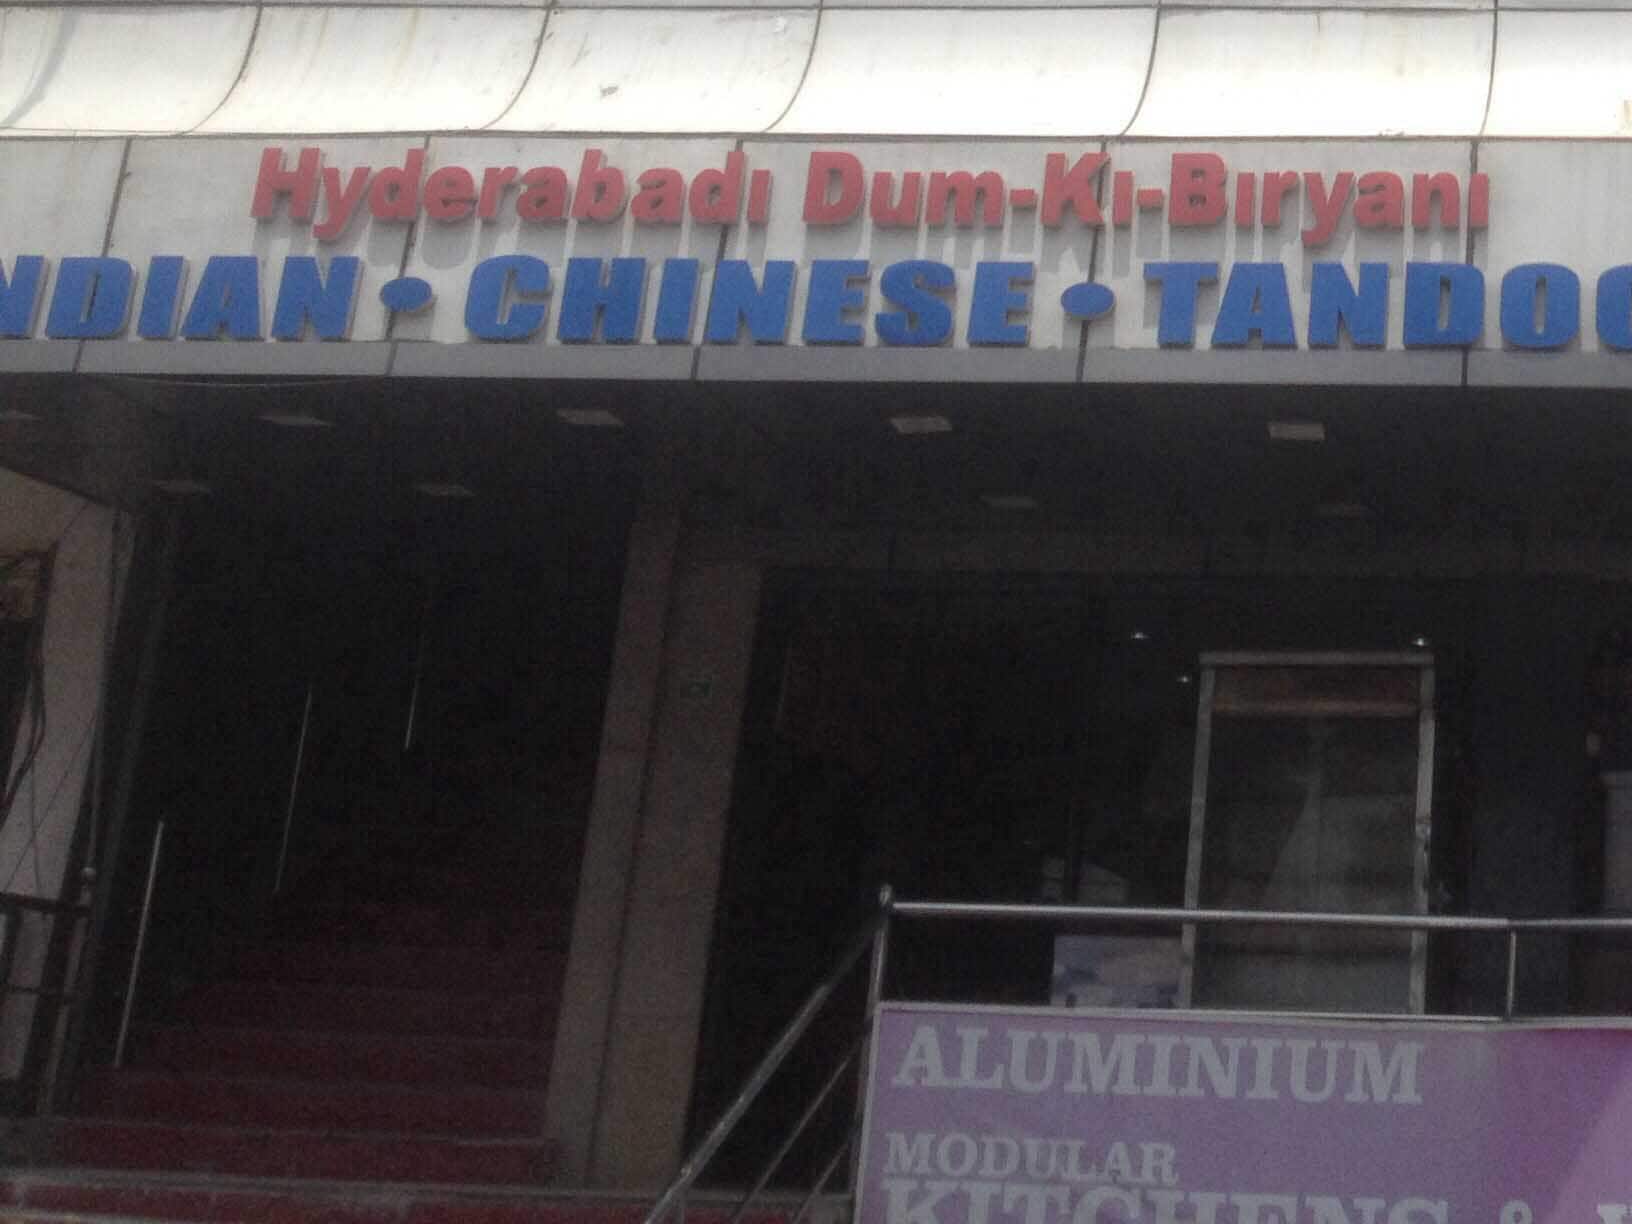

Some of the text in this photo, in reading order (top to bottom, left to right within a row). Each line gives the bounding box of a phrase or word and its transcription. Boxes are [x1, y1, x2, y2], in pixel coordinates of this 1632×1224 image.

[250, 147, 772, 240] Hyderabadi
[464, 255, 1034, 347] CHINESE
[894, 1024, 1425, 1105] ALUMINIUM
[884, 1131, 1179, 1186] MODULAR
